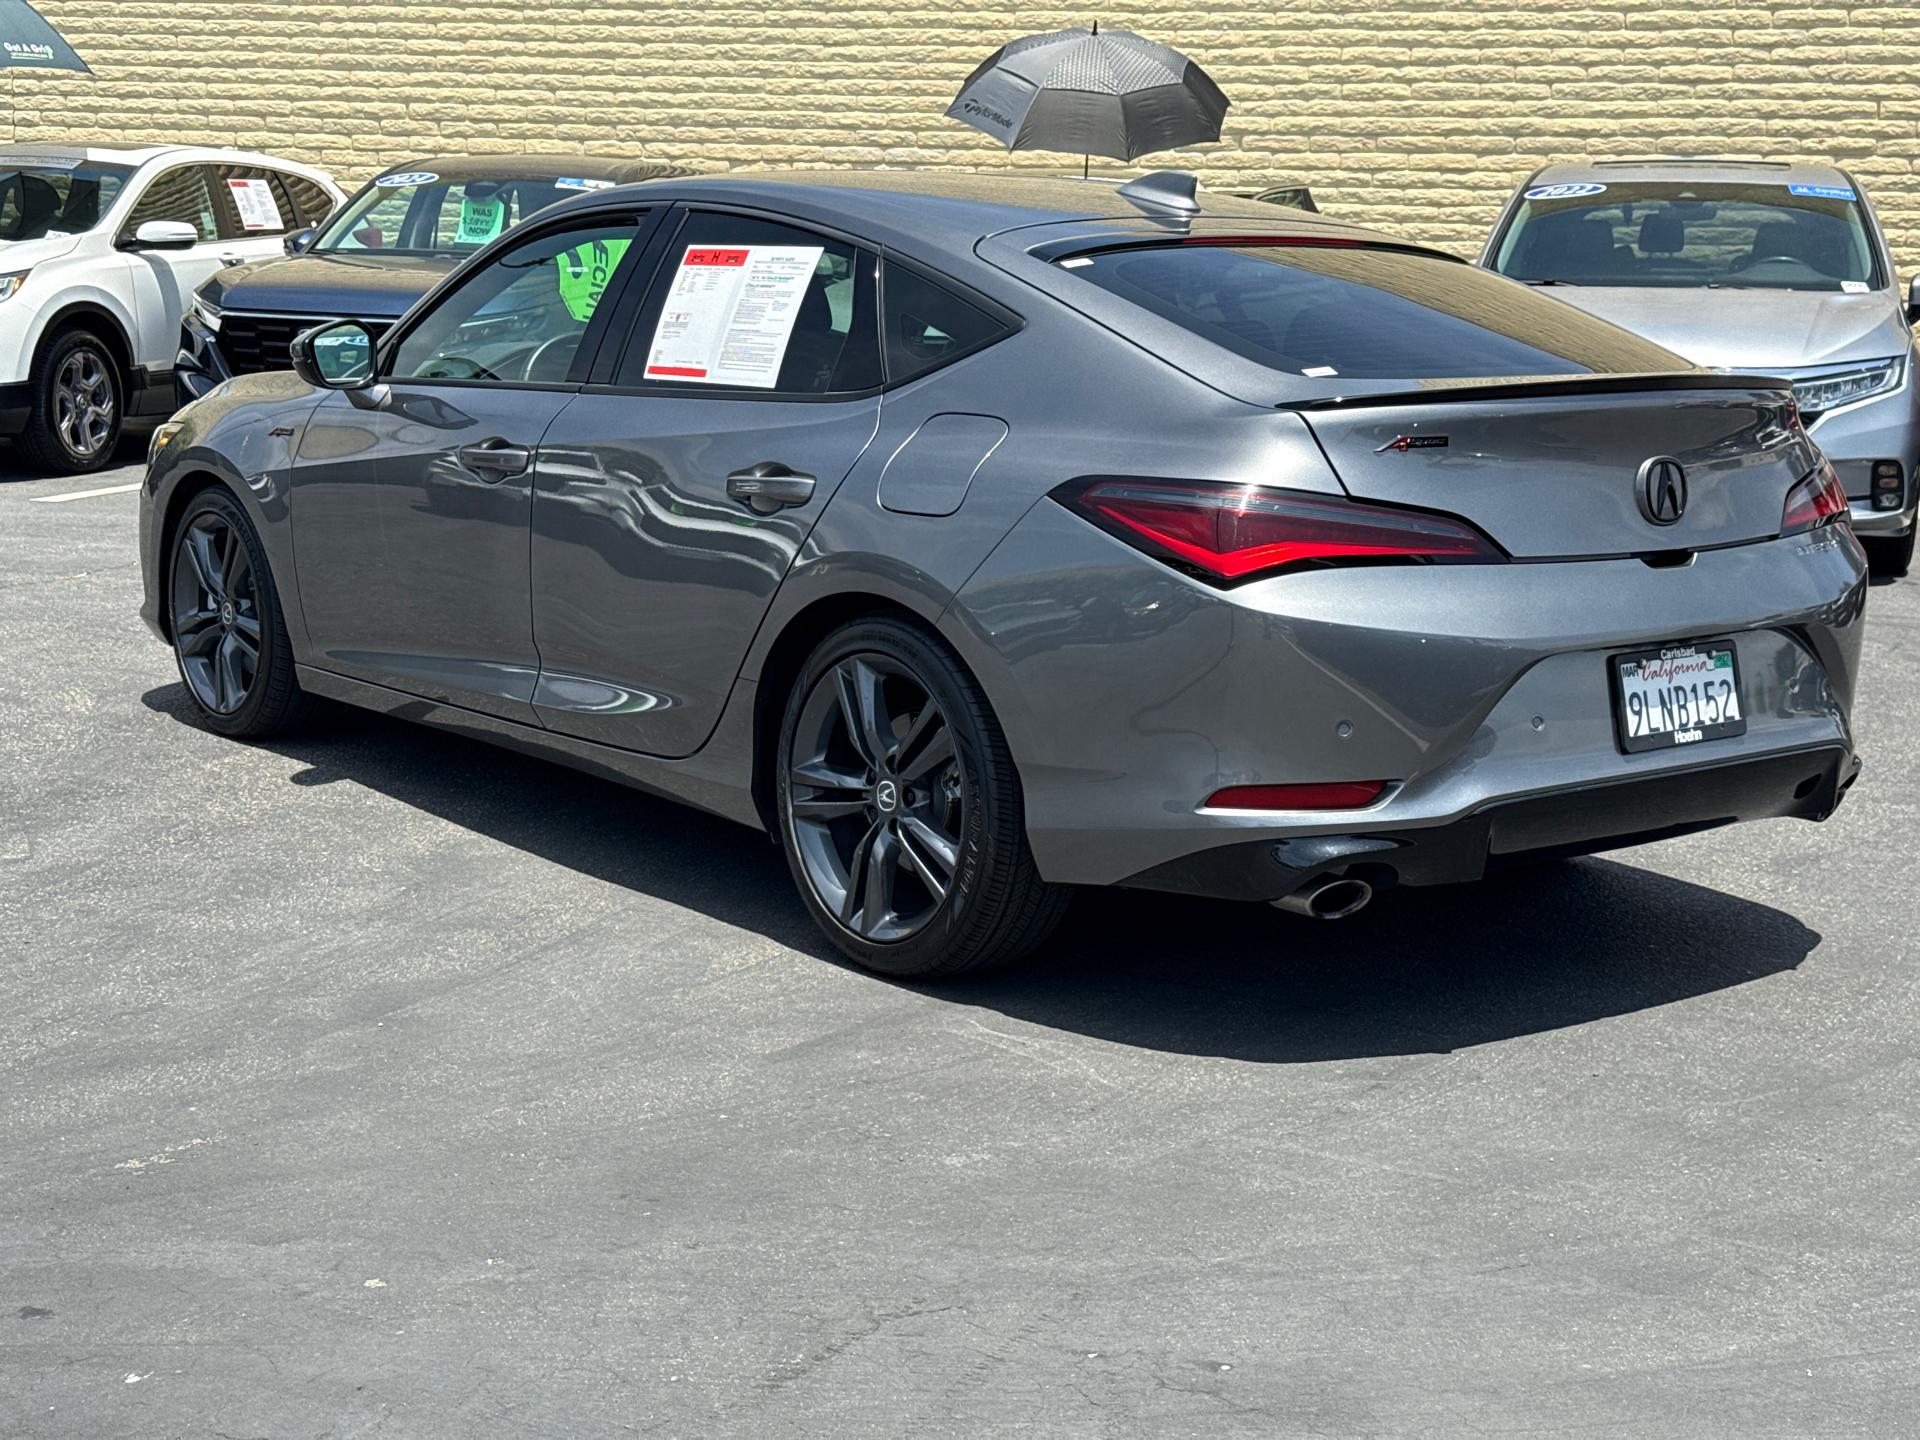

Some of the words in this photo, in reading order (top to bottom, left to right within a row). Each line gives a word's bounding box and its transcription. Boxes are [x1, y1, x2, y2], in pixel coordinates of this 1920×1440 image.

[22, 44, 31, 53] A
[1535, 184, 1596, 198] 2022
[472, 207, 493, 217] WAS
[468, 226, 489, 236] NOW
[1660, 647, 1697, 660] Carlsbad
[1622, 665, 1639, 678] MAR
[1641, 660, 1716, 684] California
[1628, 679, 1736, 736] 9LNB152
[1674, 730, 1703, 744] Hoehn
